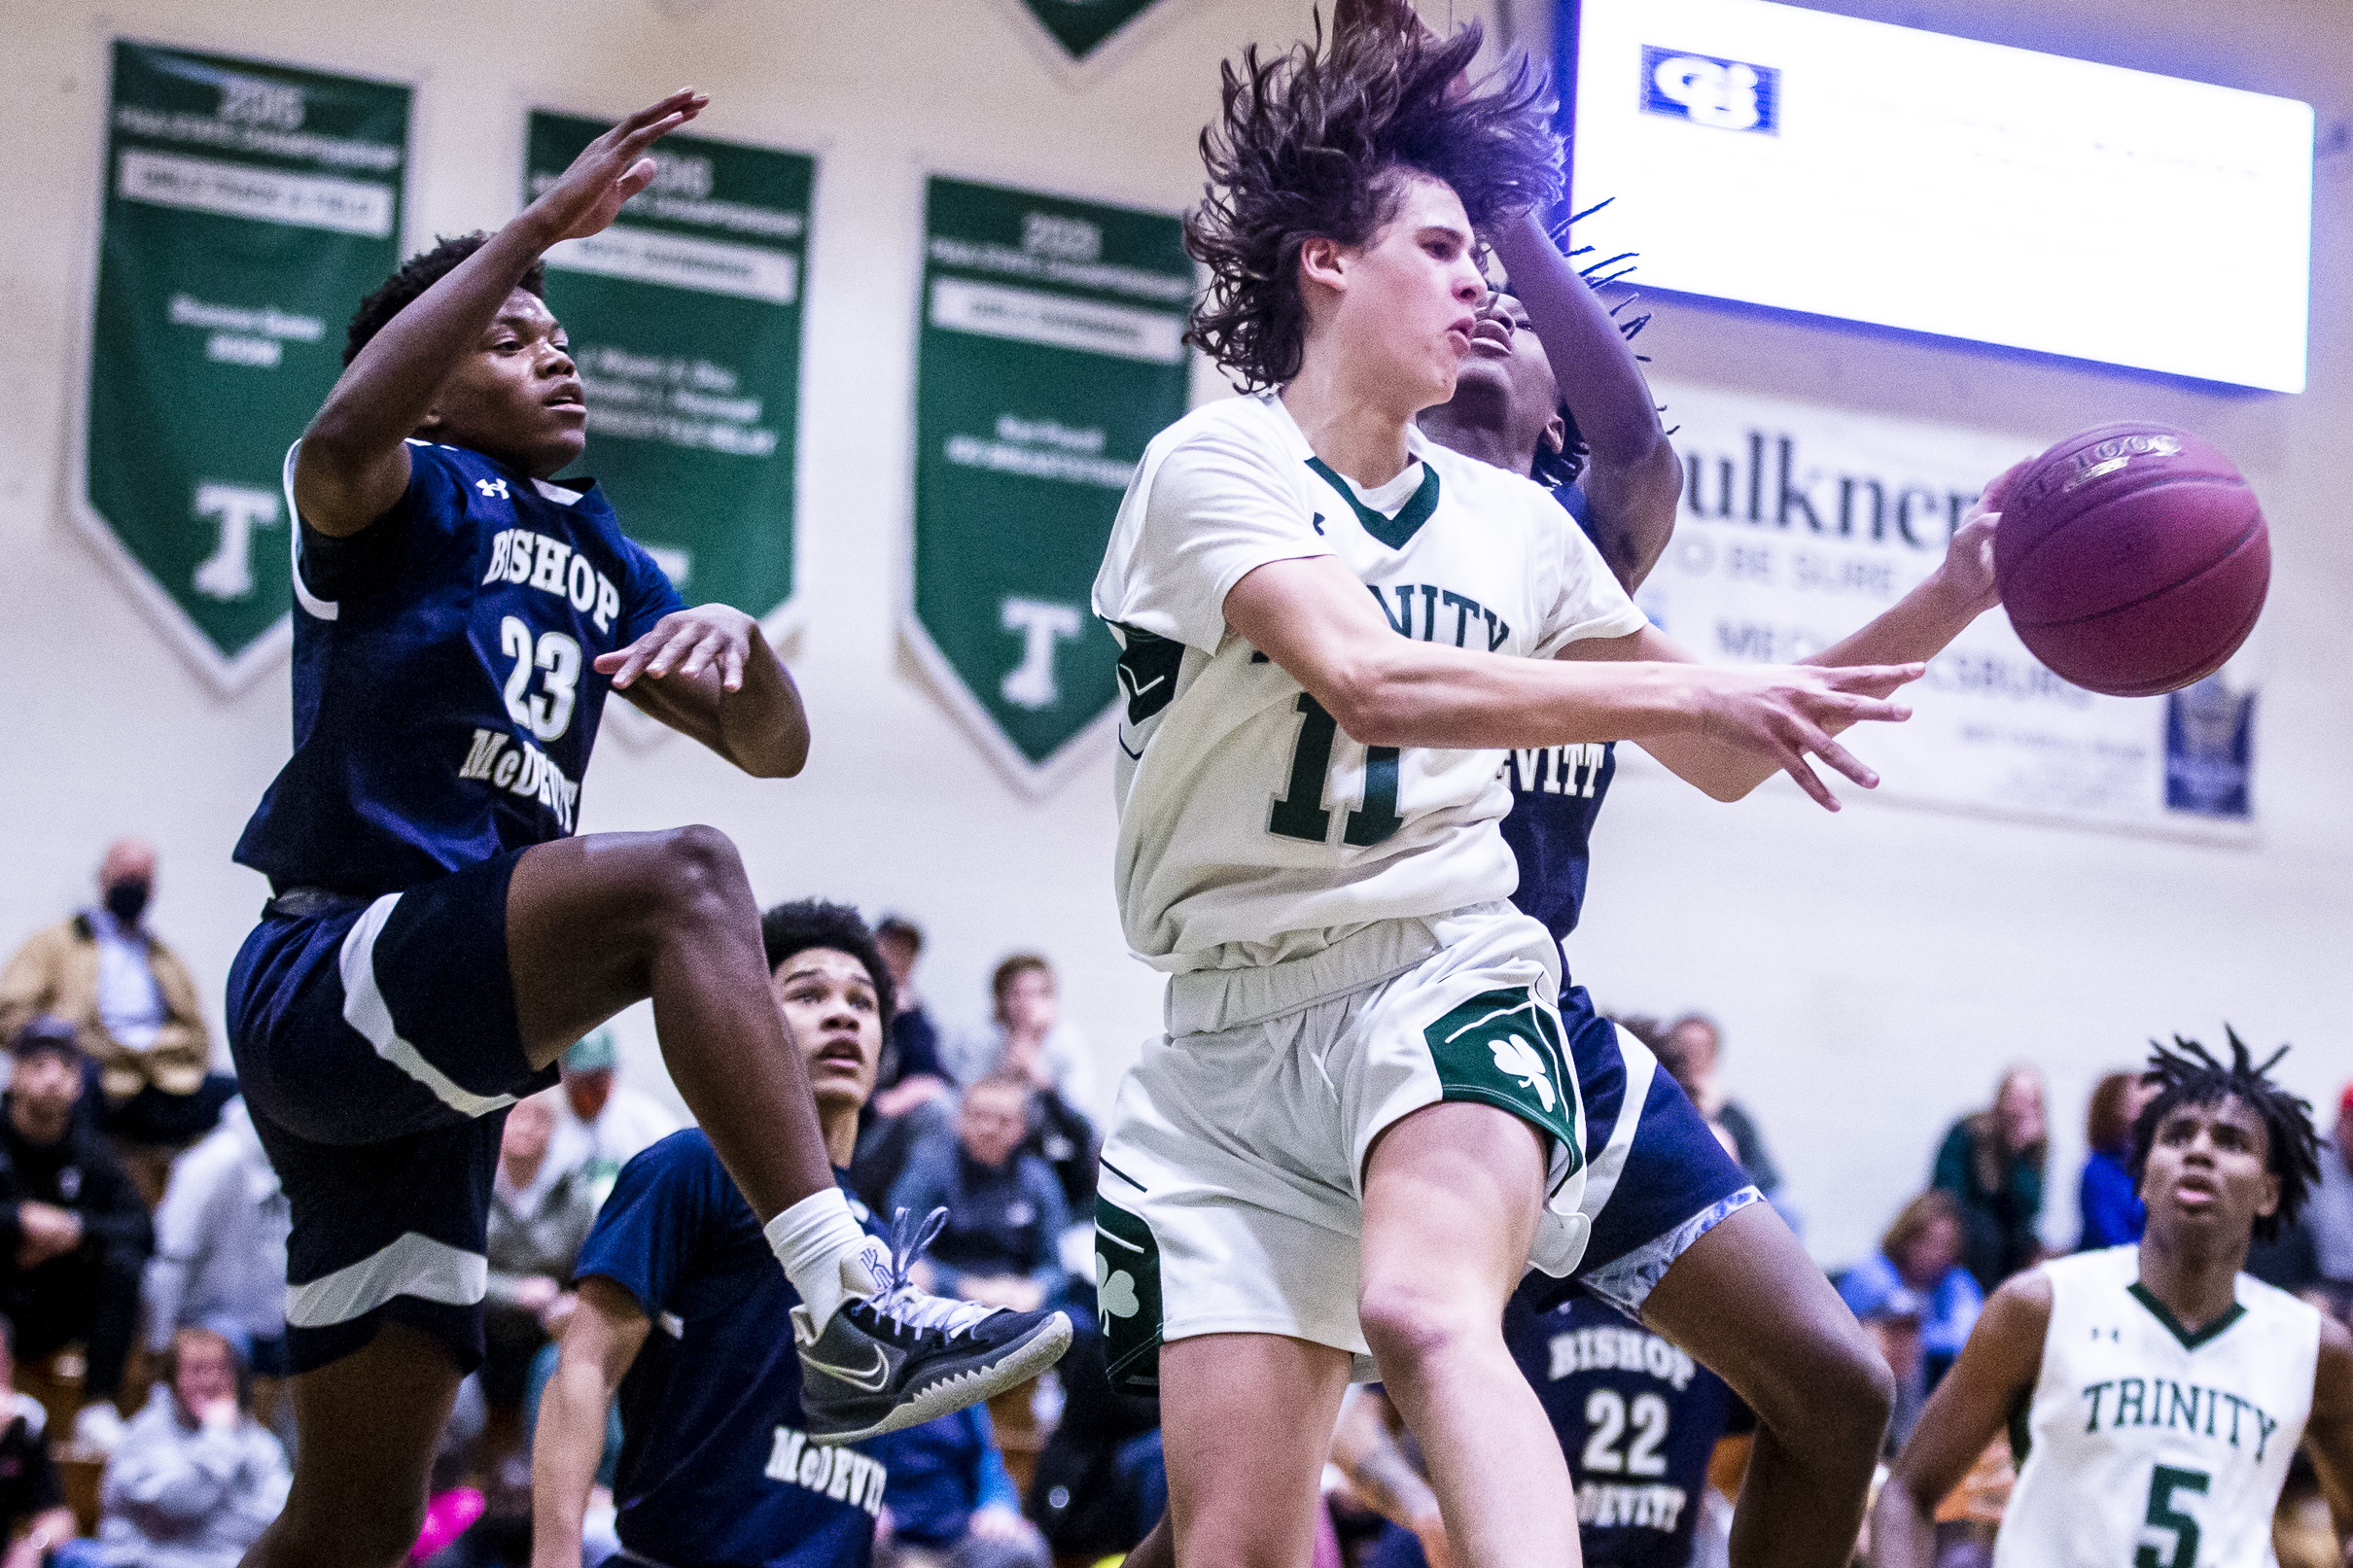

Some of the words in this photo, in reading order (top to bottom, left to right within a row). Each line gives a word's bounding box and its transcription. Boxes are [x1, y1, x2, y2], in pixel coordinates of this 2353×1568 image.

[194, 482, 279, 598] T
[1686, 429, 1980, 551] ulkner
[481, 528, 621, 635] BISHOP
[501, 614, 582, 742] 23
[1001, 596, 1082, 710] T
[1267, 691, 1409, 848] 11
[1501, 742, 1606, 799] VITT
[1549, 1324, 1696, 1391] BISHOP
[1581, 1387, 1670, 1477] 22
[2082, 1376, 2278, 1465] TRINITY
[2133, 1464, 2212, 1568] 5
